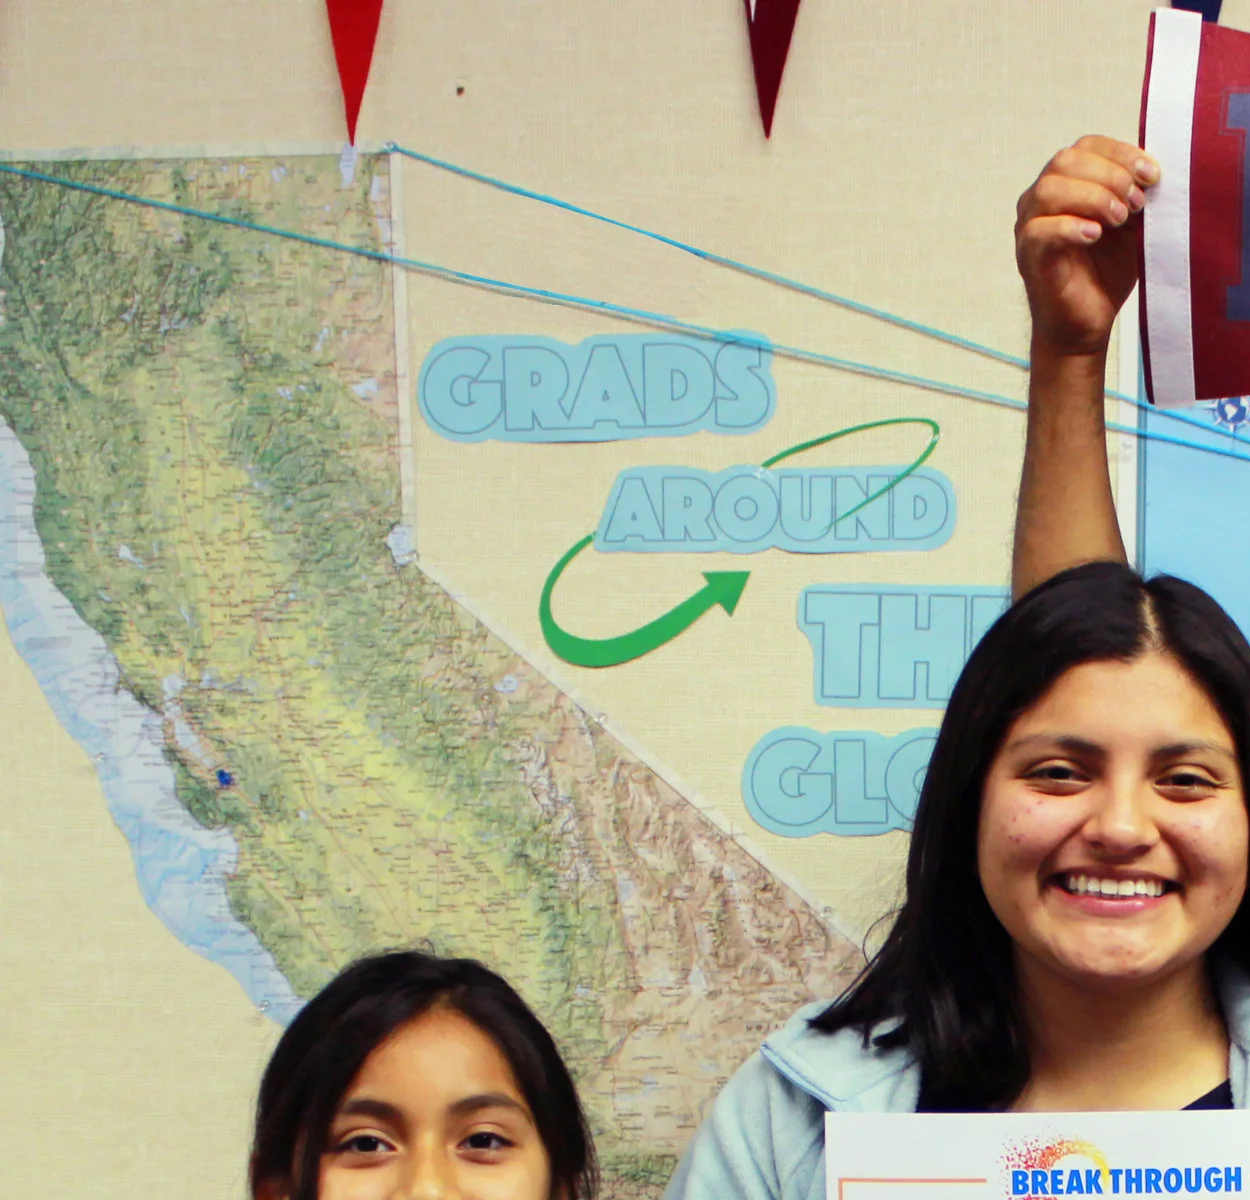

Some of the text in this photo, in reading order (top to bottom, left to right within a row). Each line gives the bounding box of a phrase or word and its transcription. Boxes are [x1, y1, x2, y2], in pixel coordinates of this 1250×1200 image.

[422, 342, 770, 434] GRADS
[603, 474, 949, 543] AROUND
[805, 591, 1012, 701] TH
[1011, 1166, 1243, 1195] BREAK THROUGH
